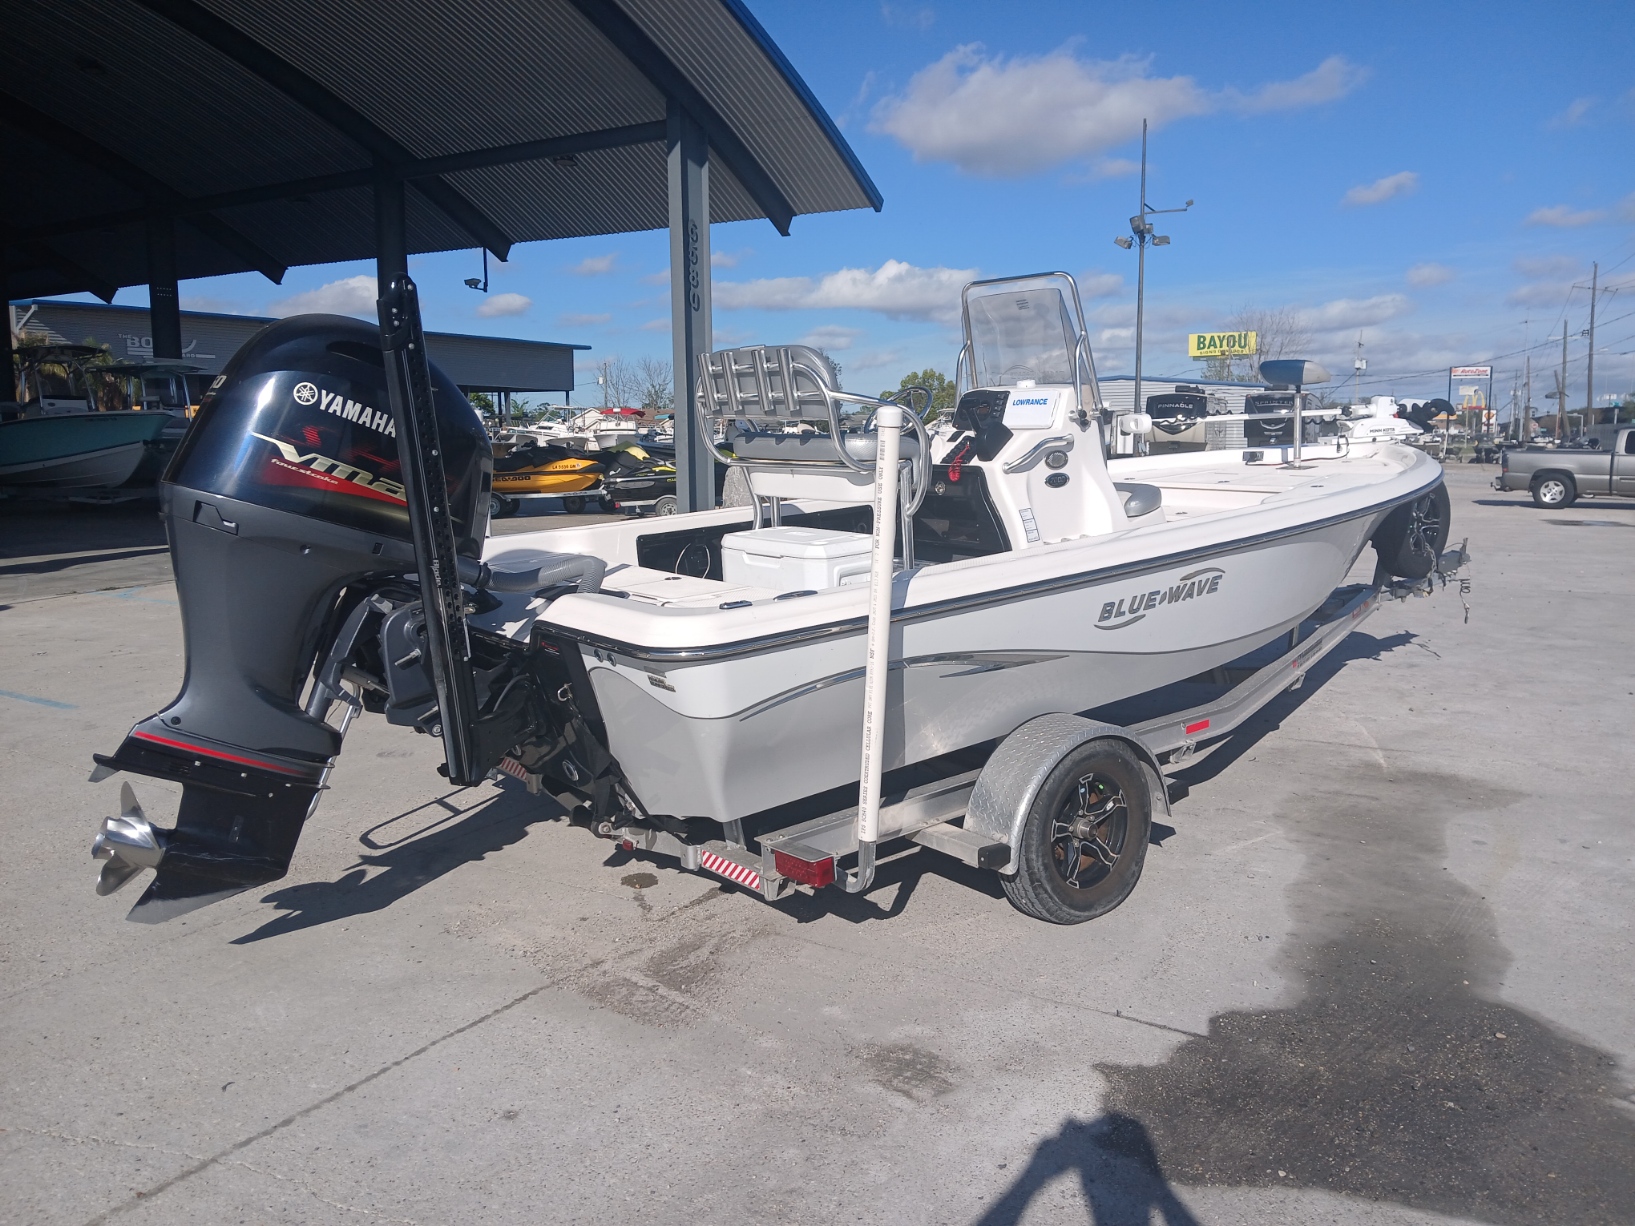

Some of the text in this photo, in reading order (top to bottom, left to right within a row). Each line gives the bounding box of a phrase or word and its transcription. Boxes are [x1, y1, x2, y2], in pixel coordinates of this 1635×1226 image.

[126, 336, 153, 348] BO
[1196, 333, 1248, 351] BAYOU
[319, 389, 397, 438] YAMAHA
[1012, 398, 1049, 406] LOWRANCE
[875, 496, 883, 537] NON-PRESSURE
[1098, 574, 1223, 623] BLUE WAVE
